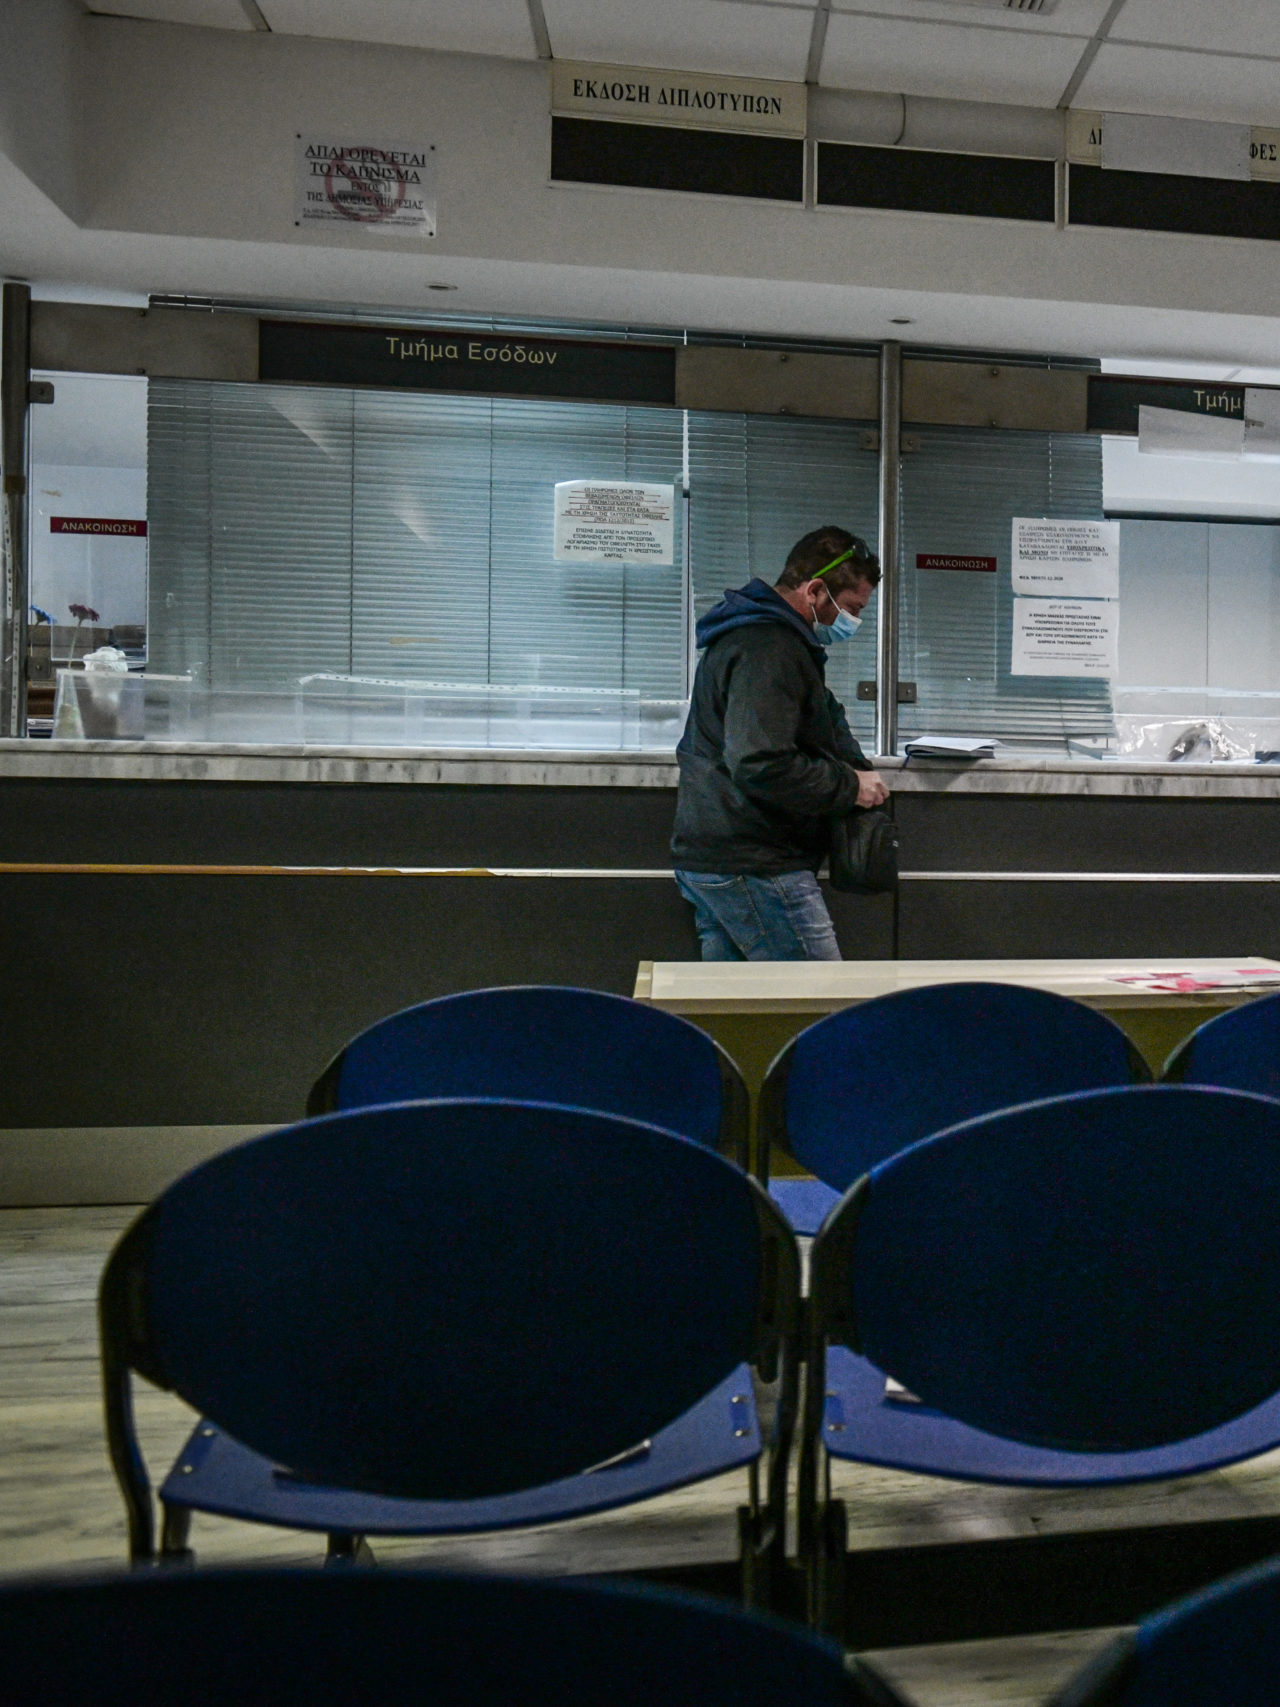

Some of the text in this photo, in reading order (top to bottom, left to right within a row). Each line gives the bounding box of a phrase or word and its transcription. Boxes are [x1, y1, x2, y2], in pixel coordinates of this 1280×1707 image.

[573, 79, 781, 115] ΕΚΔΟΣΗ ΔΙΠΛΟΤΥΠΩΝ
[305, 145, 425, 165] ΑΠΑΓΟΡΕΥΕΤΑΙ
[310, 162, 420, 182] ΤΟ ΚΑΠΝΙΣΜΑ
[307, 191, 323, 201] ΤΗΣ
[386, 337, 557, 364] Τμήμα Εσόδων
[1193, 390, 1244, 412] Τμήμ
[62, 522, 136, 533] ΑΝΑΚΟΙΝΩΣΗ
[926, 559, 988, 568] ΑΝΑΚΟΙΝΩΣΗ
